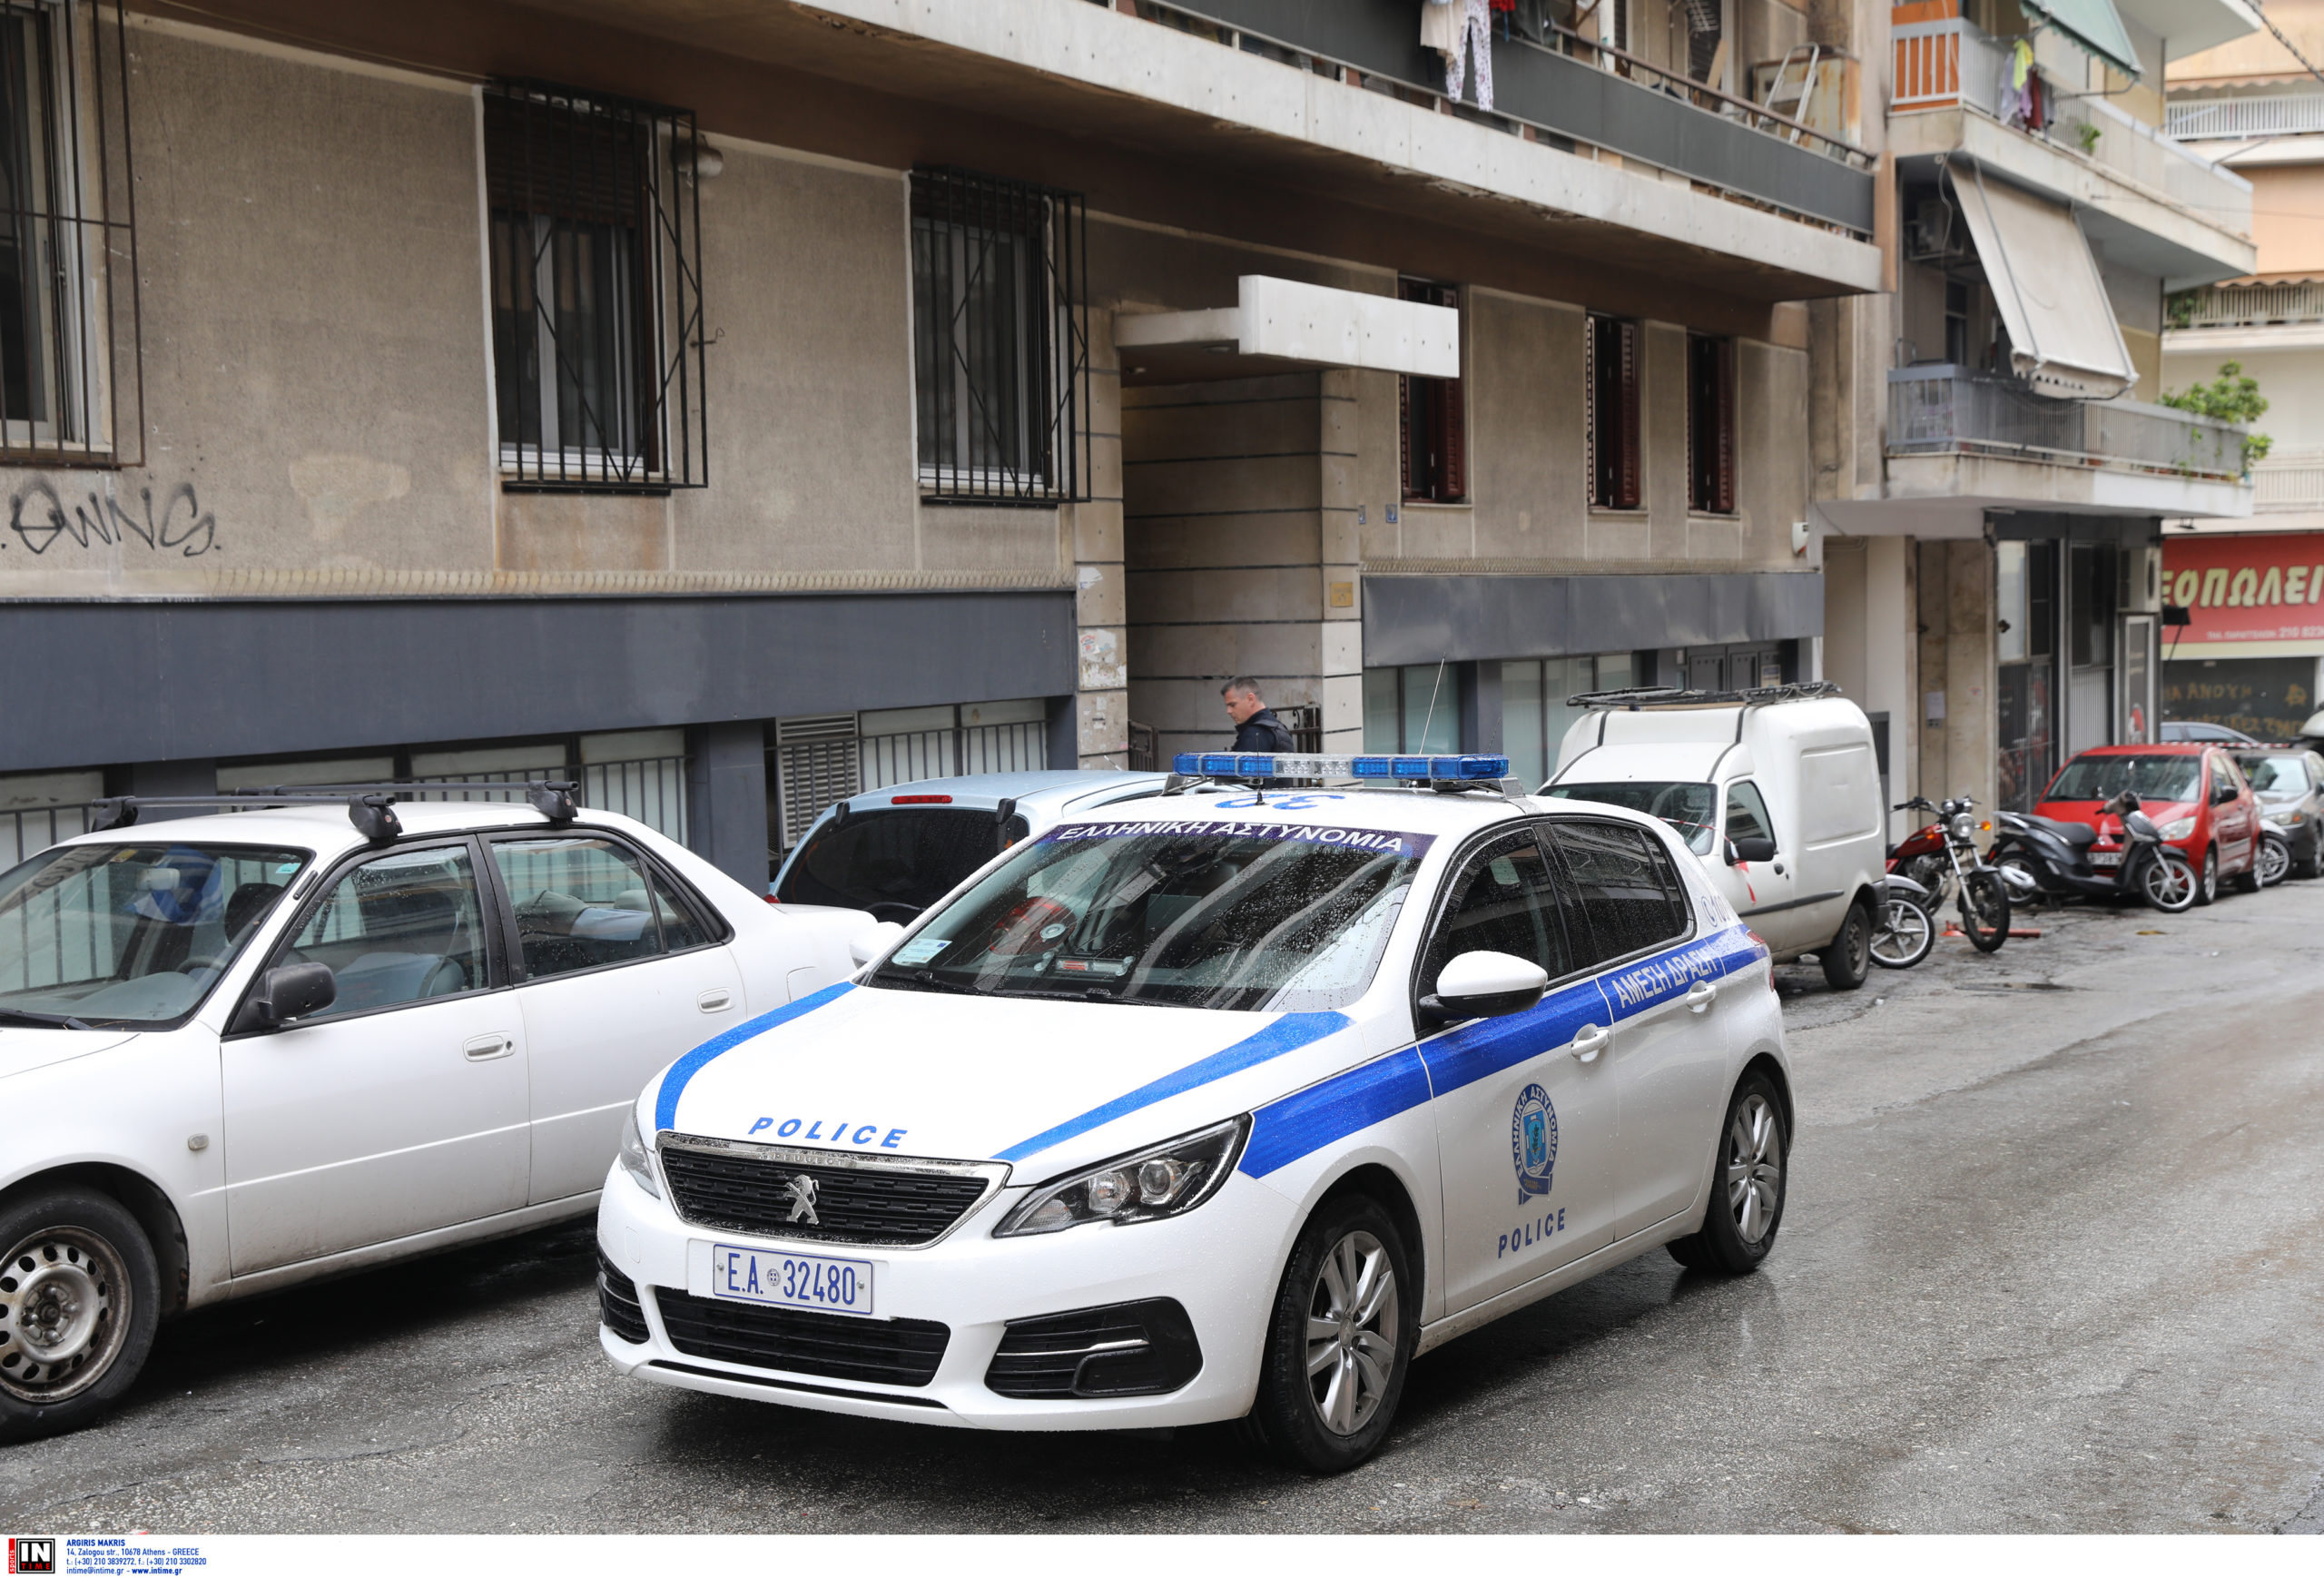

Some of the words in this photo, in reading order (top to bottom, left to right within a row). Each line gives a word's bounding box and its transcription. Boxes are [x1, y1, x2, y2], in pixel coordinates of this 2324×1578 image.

[1056, 822, 1214, 841] ΕΛΛΗΝΙΚΗ
[1210, 822, 1403, 852] ΑΣΤΥΝΟΜΙΑ
[1611, 962, 1673, 1009] ΑΜΕΣΗ
[1664, 948, 1718, 987] ΔΡΑΣΗ
[748, 1117, 909, 1149] POLICE
[1512, 1093, 1527, 1179] ΕΛΛΗΝΙΚΗ
[1530, 1086, 1558, 1163] ΑΣΤΥΝΟΜΙΑ
[1497, 1208, 1567, 1259] POLICE
[783, 1259, 856, 1306] 32480
